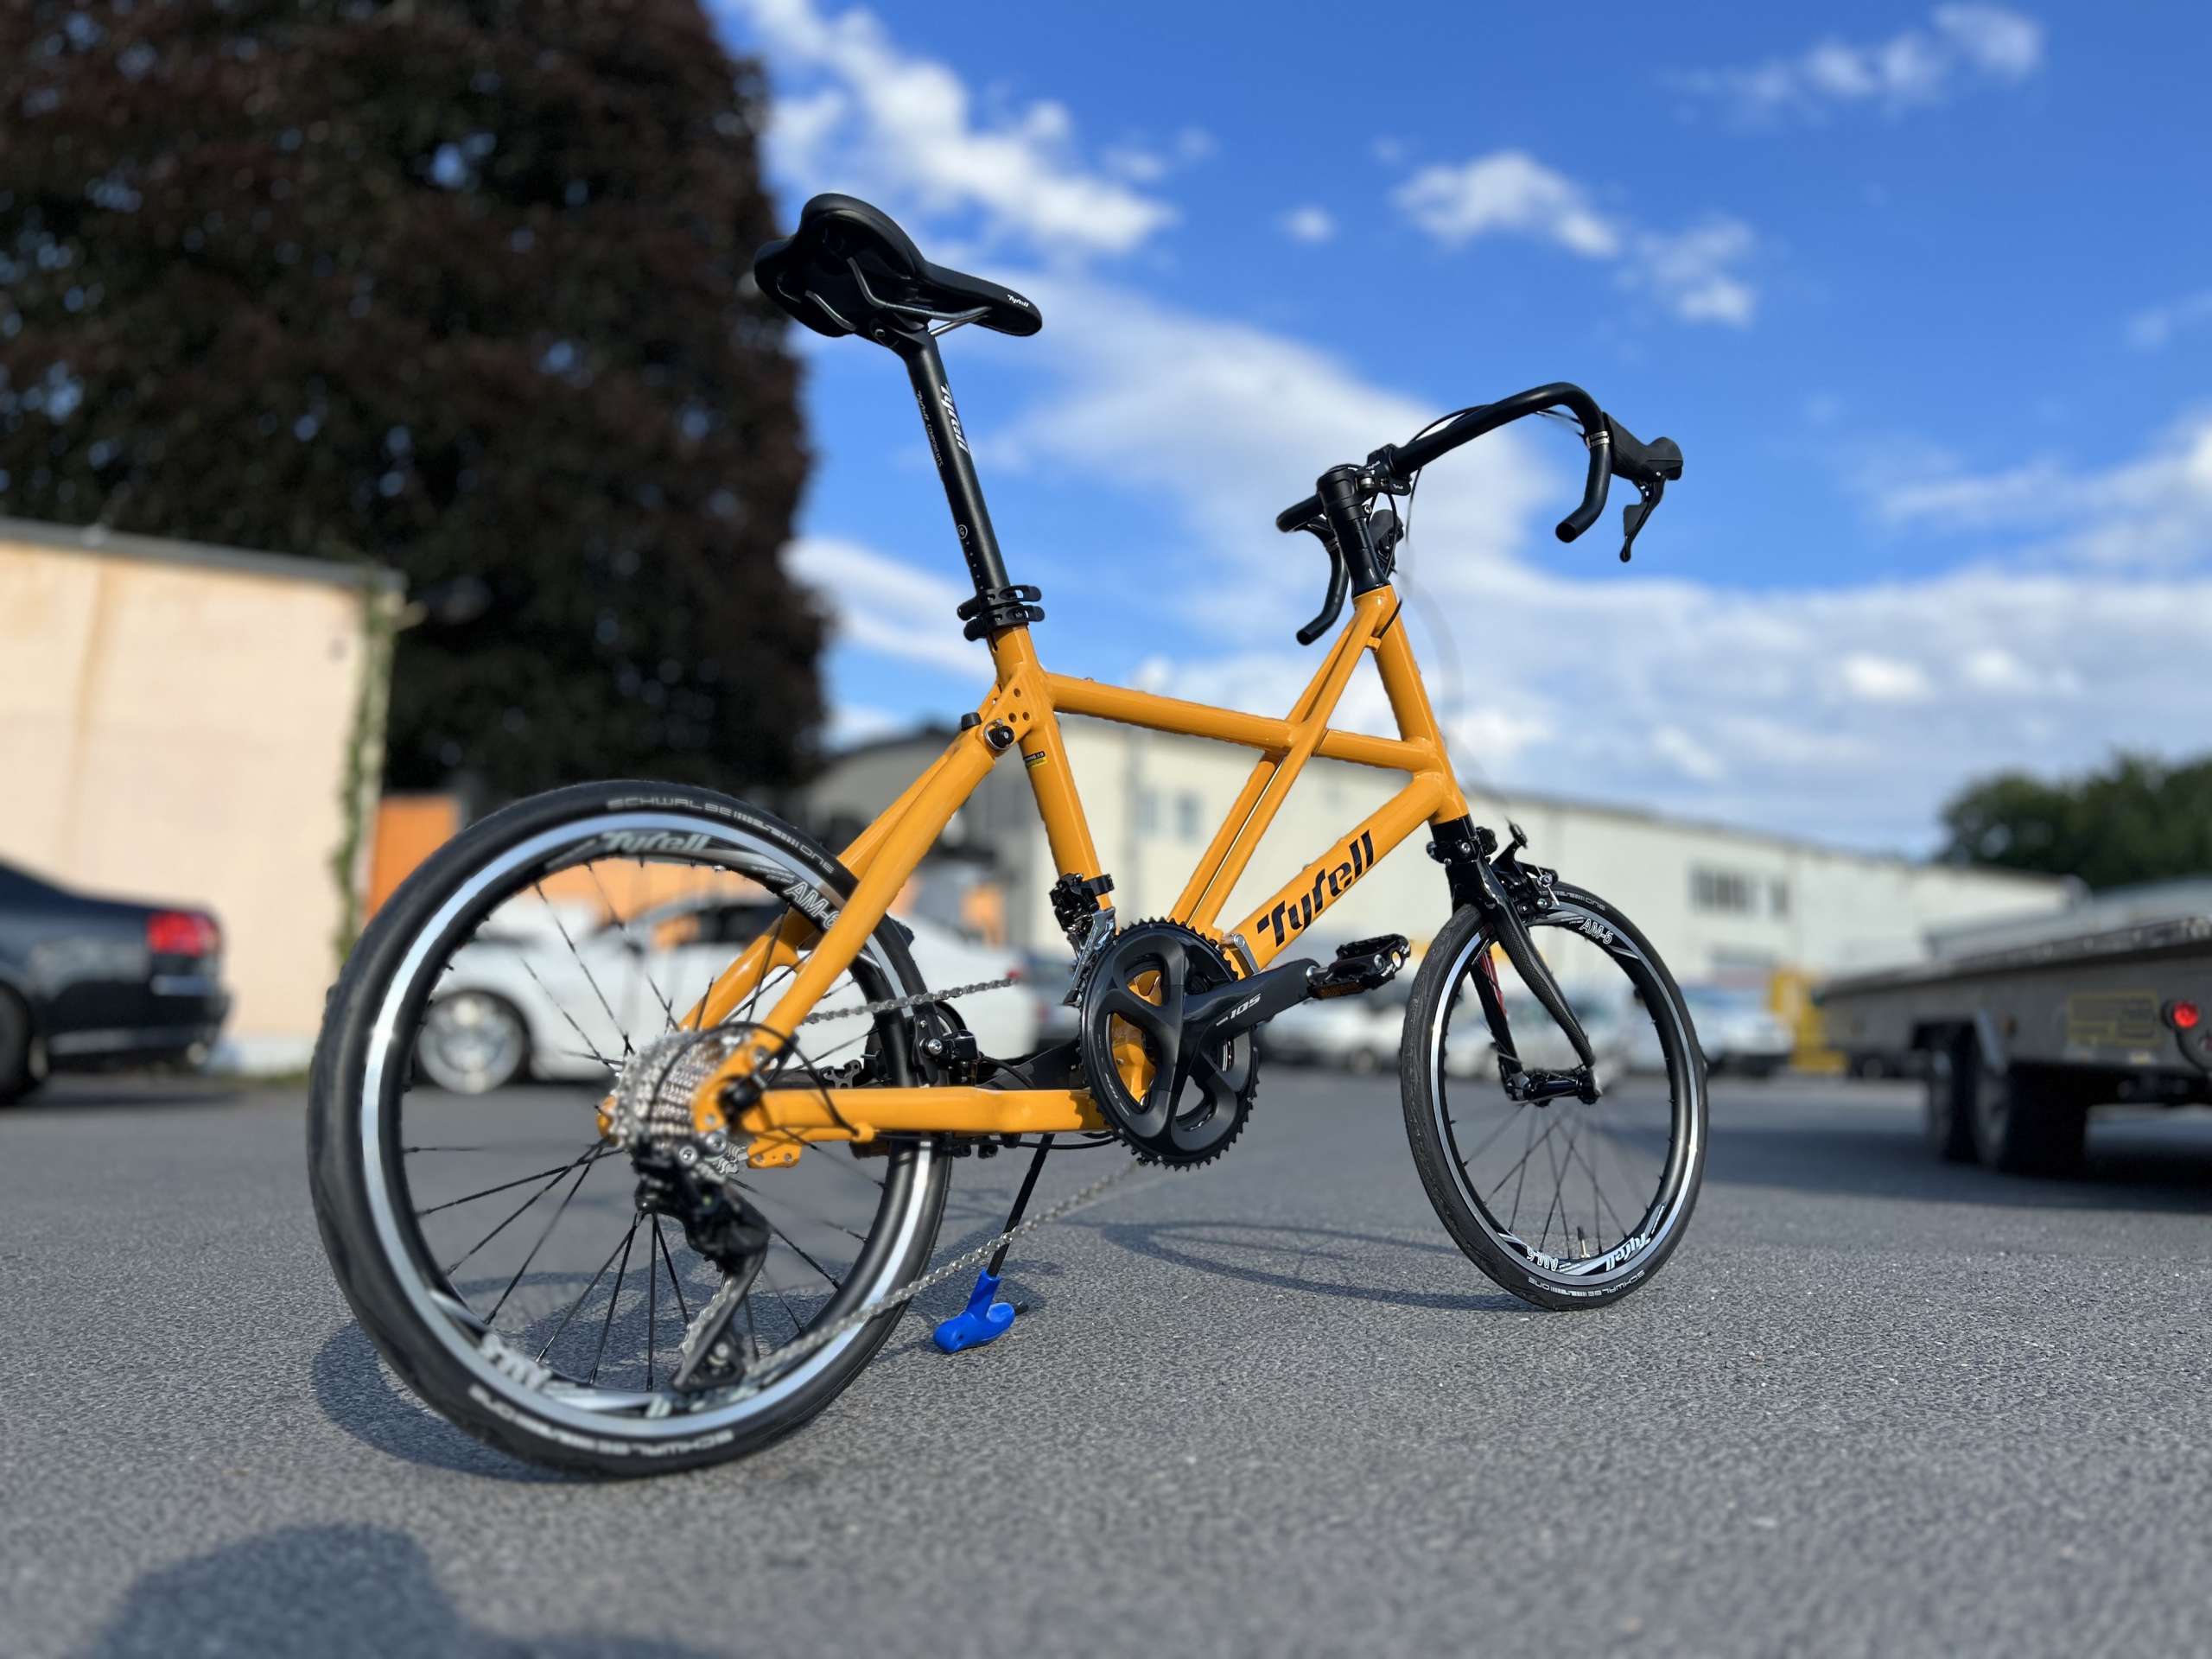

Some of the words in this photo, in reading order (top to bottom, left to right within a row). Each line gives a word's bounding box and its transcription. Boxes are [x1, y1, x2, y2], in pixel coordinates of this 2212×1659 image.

[607, 797, 732, 817] SCHWALBE
[600, 830, 711, 853] Tyrell
[1257, 830, 1374, 947] Tyrell
[1230, 993, 1262, 1020] 105
[1587, 1269, 1645, 1297] SCHWALBE
